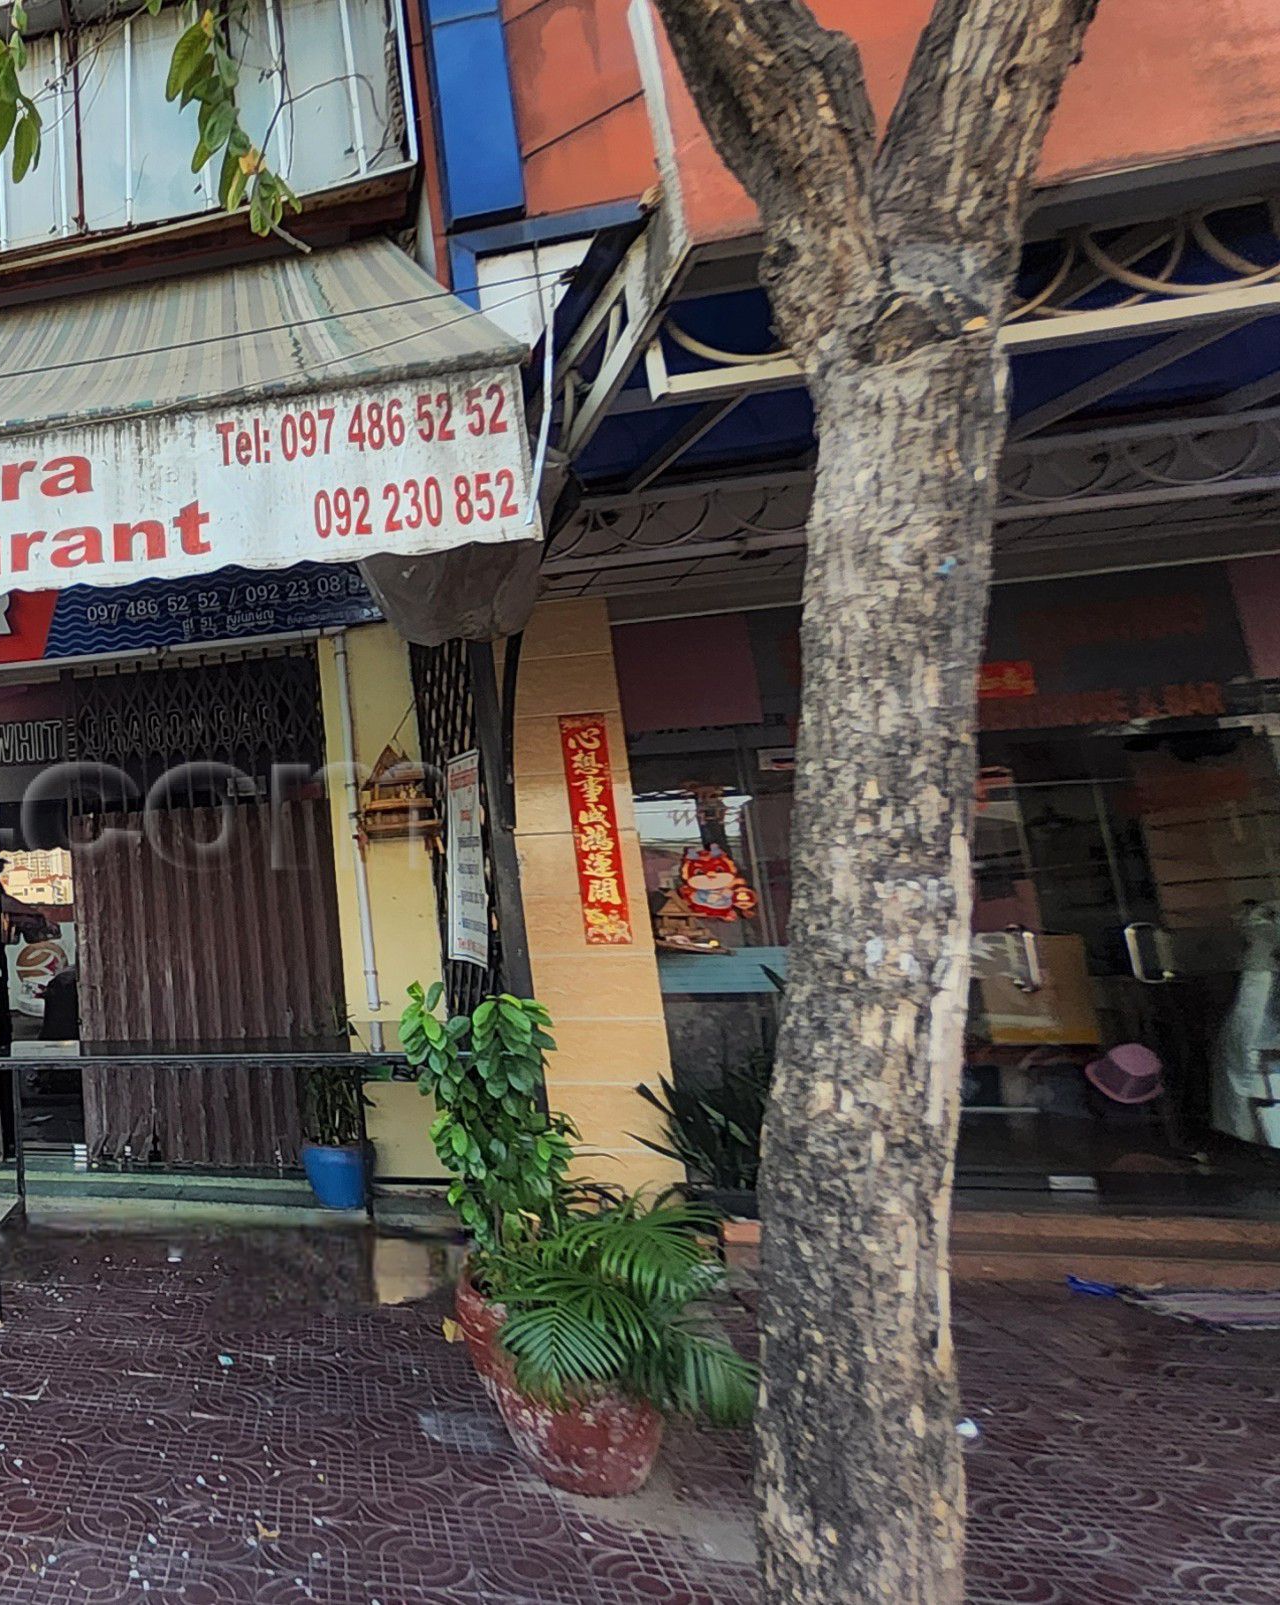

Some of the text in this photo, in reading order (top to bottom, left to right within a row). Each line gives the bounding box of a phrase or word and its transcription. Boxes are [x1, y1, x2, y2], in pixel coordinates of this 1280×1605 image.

[216, 383, 509, 466] Tel: 097 486 52 52
[313, 467, 519, 540] 092 230 852
[86, 603, 119, 622] 097
[125, 598, 158, 617] 486
[167, 595, 189, 612] 52
[197, 591, 220, 608] 52
[245, 583, 280, 603] 092
[287, 579, 310, 598] 23
[317, 575, 342, 594] 08
